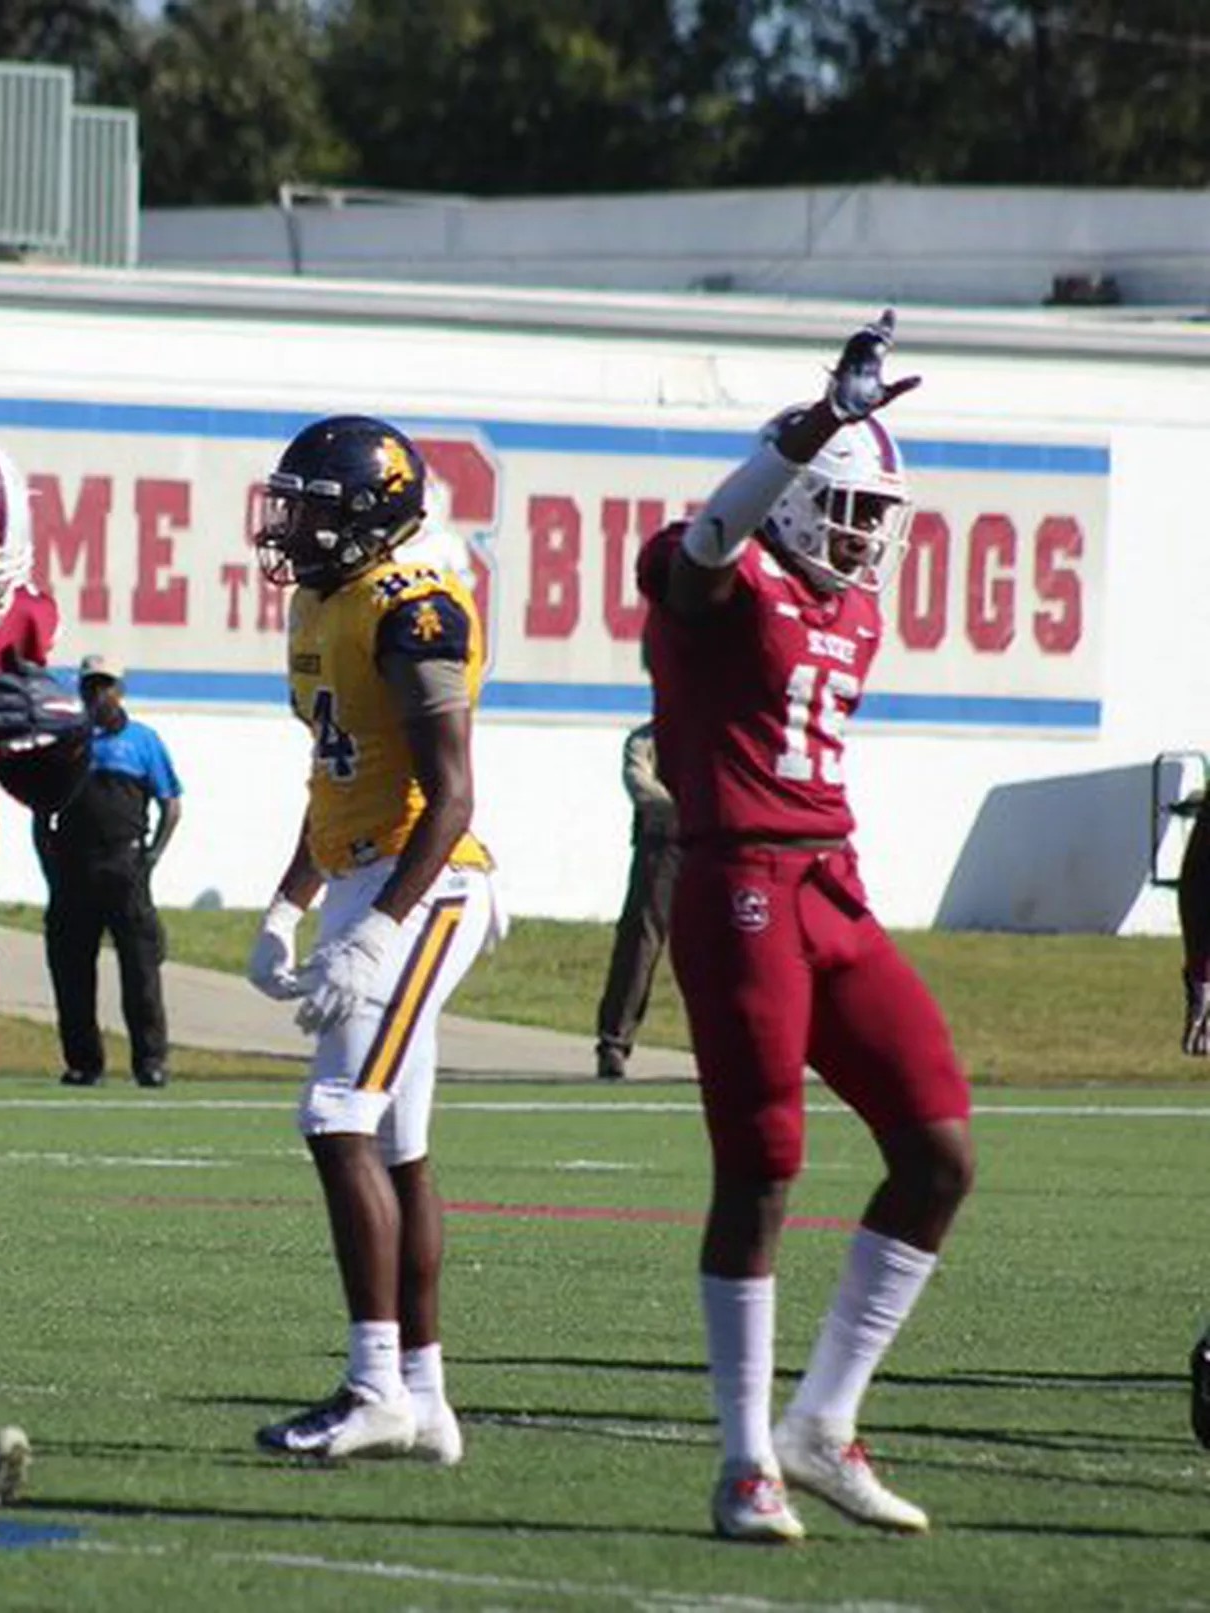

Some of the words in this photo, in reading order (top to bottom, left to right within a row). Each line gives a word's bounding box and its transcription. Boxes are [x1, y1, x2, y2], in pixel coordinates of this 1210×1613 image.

[27, 474, 192, 626] ME
[525, 494, 1084, 656] BUOGS
[775, 663, 860, 785] 15
